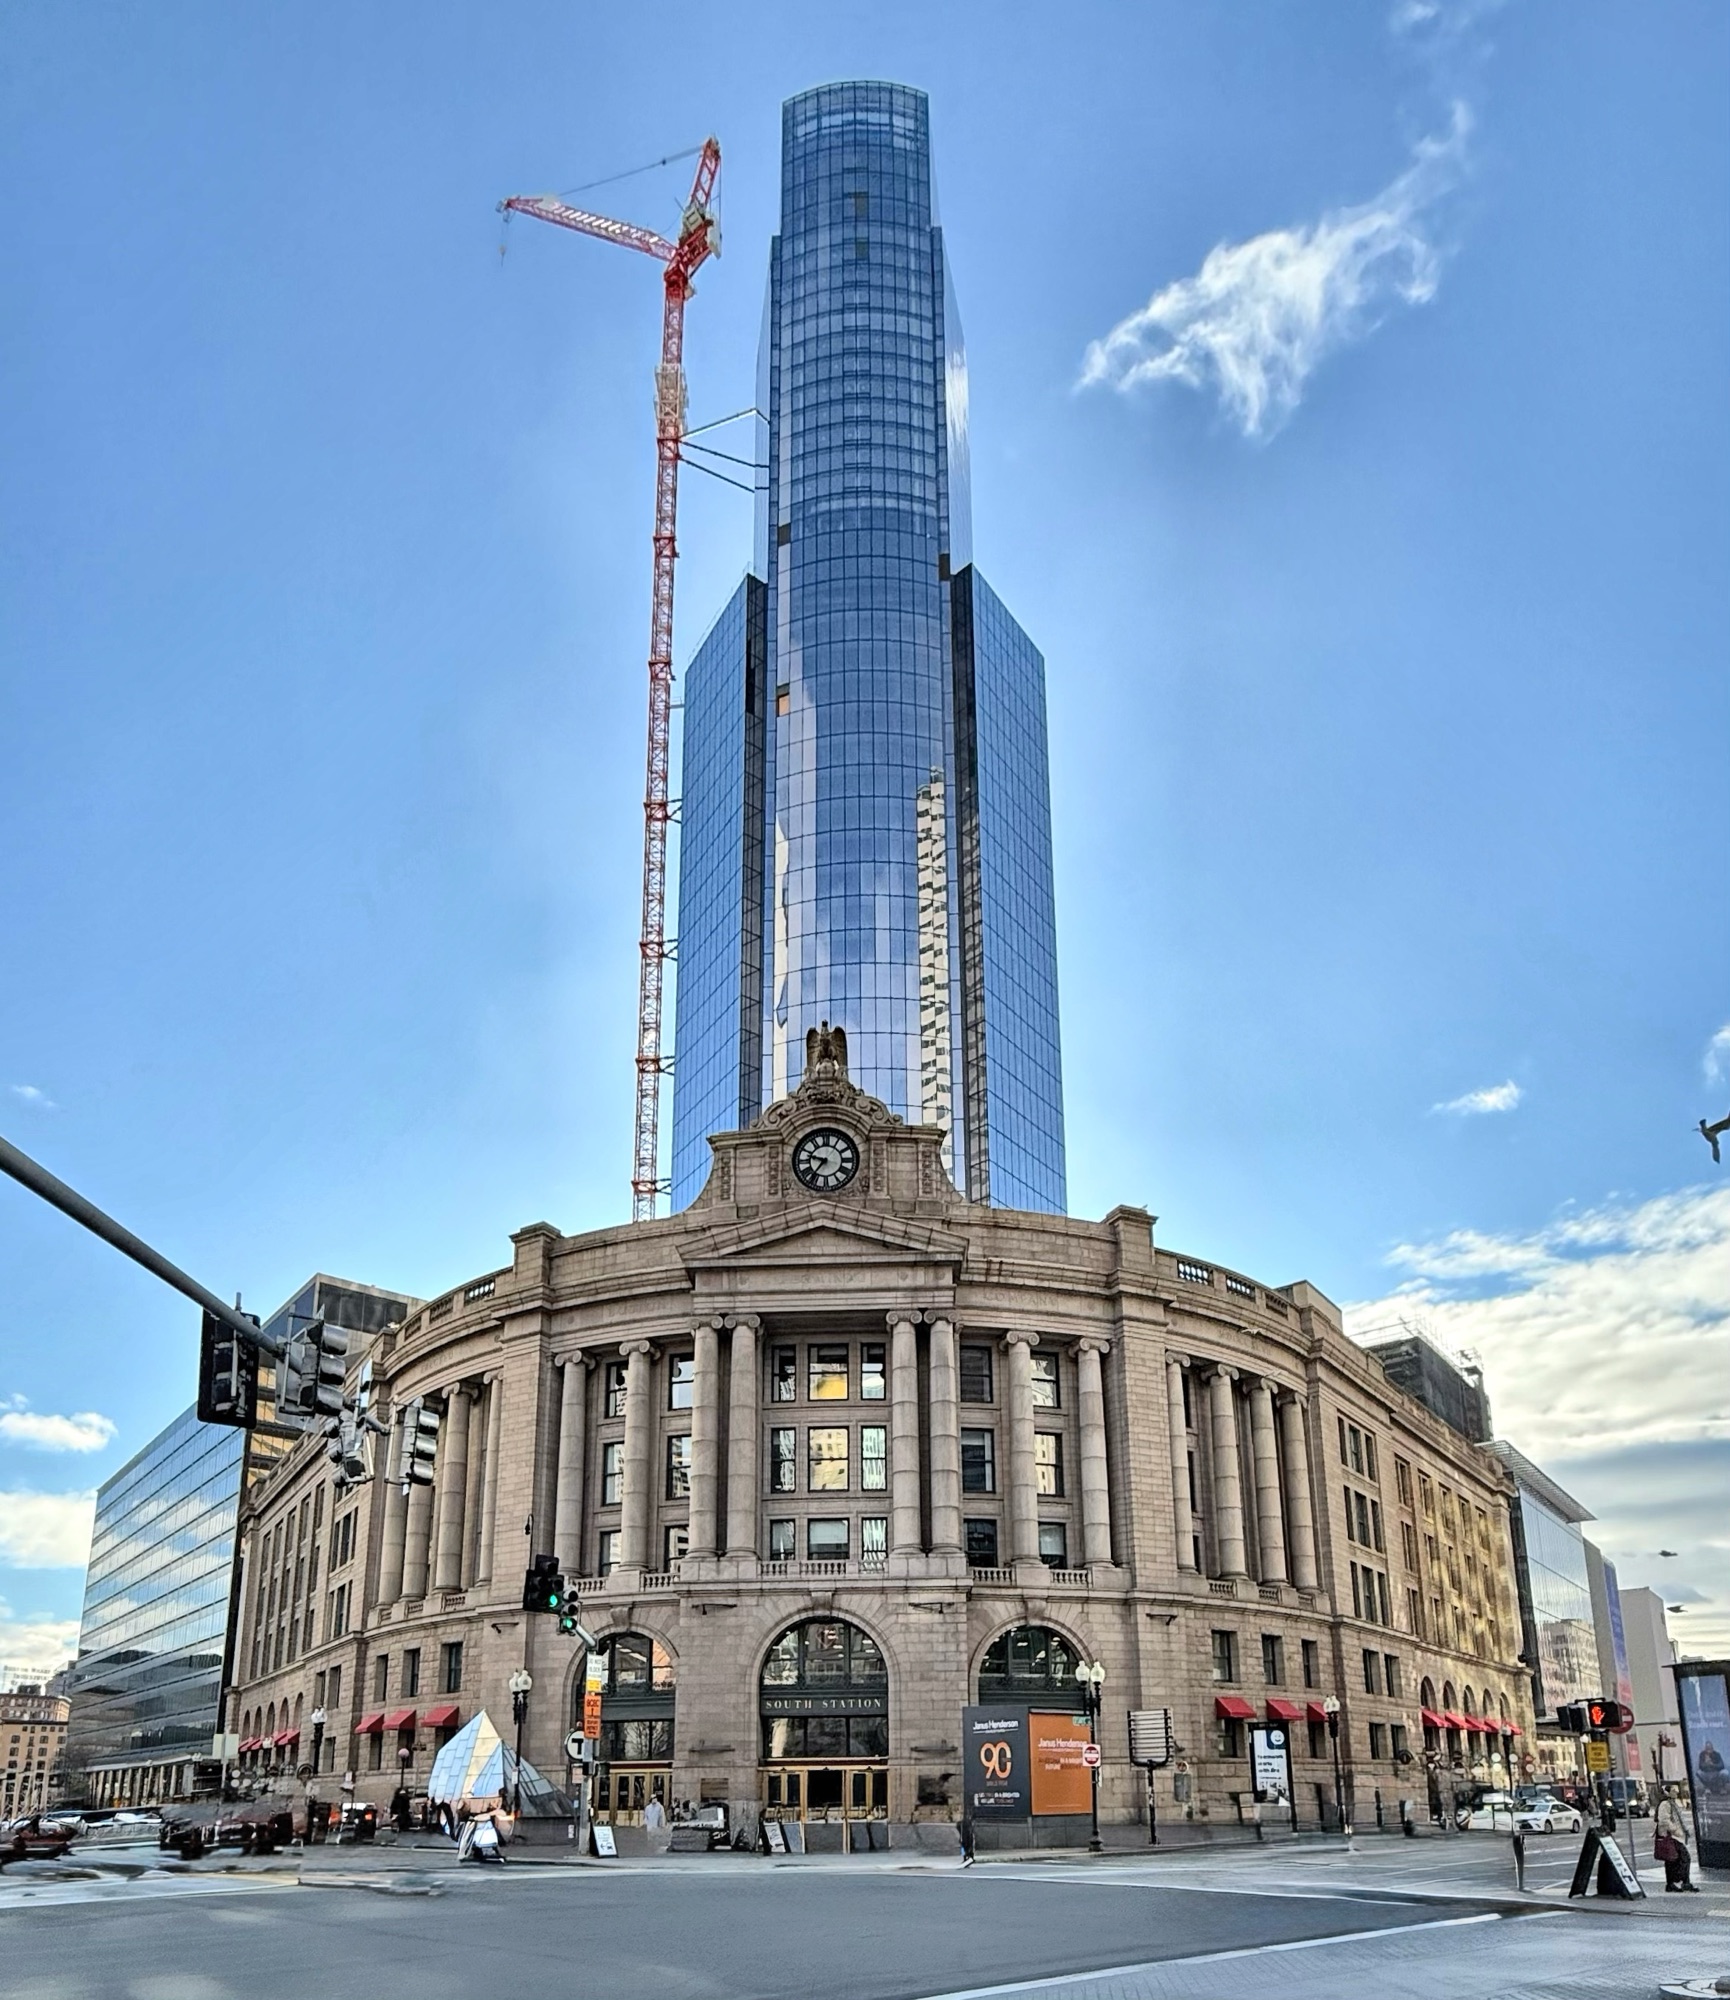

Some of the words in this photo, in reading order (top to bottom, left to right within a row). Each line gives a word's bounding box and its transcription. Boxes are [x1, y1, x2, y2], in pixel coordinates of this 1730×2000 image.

[765, 1699, 812, 1709] SOUTH
[822, 1698, 881, 1709] STATION
[972, 1721, 989, 1731] Janus
[989, 1719, 1019, 1729] Henderson
[571, 1738, 584, 1756] T
[1038, 1738, 1056, 1748] Janus
[980, 1741, 1012, 1780] 90
